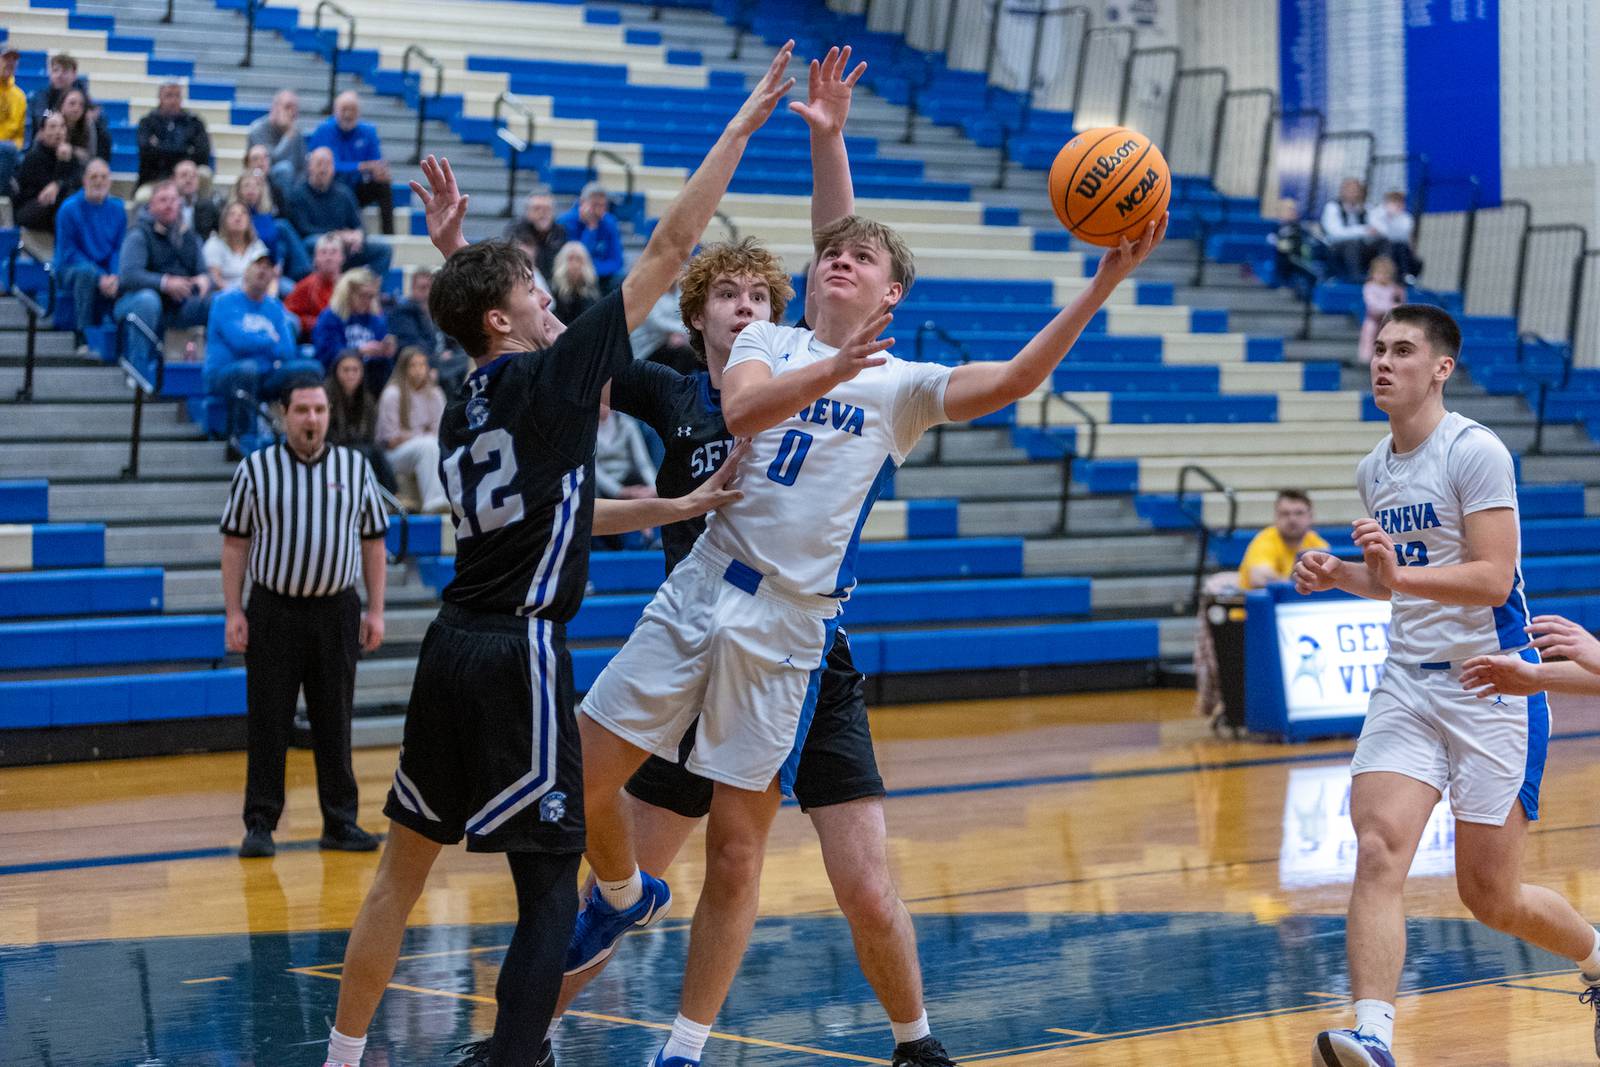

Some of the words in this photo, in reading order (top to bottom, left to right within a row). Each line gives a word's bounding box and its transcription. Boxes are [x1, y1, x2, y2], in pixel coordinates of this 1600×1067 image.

[1075, 139, 1140, 199] Wilson
[1115, 167, 1159, 217] NCAA
[443, 428, 525, 540] 12
[766, 429, 814, 487] 0
